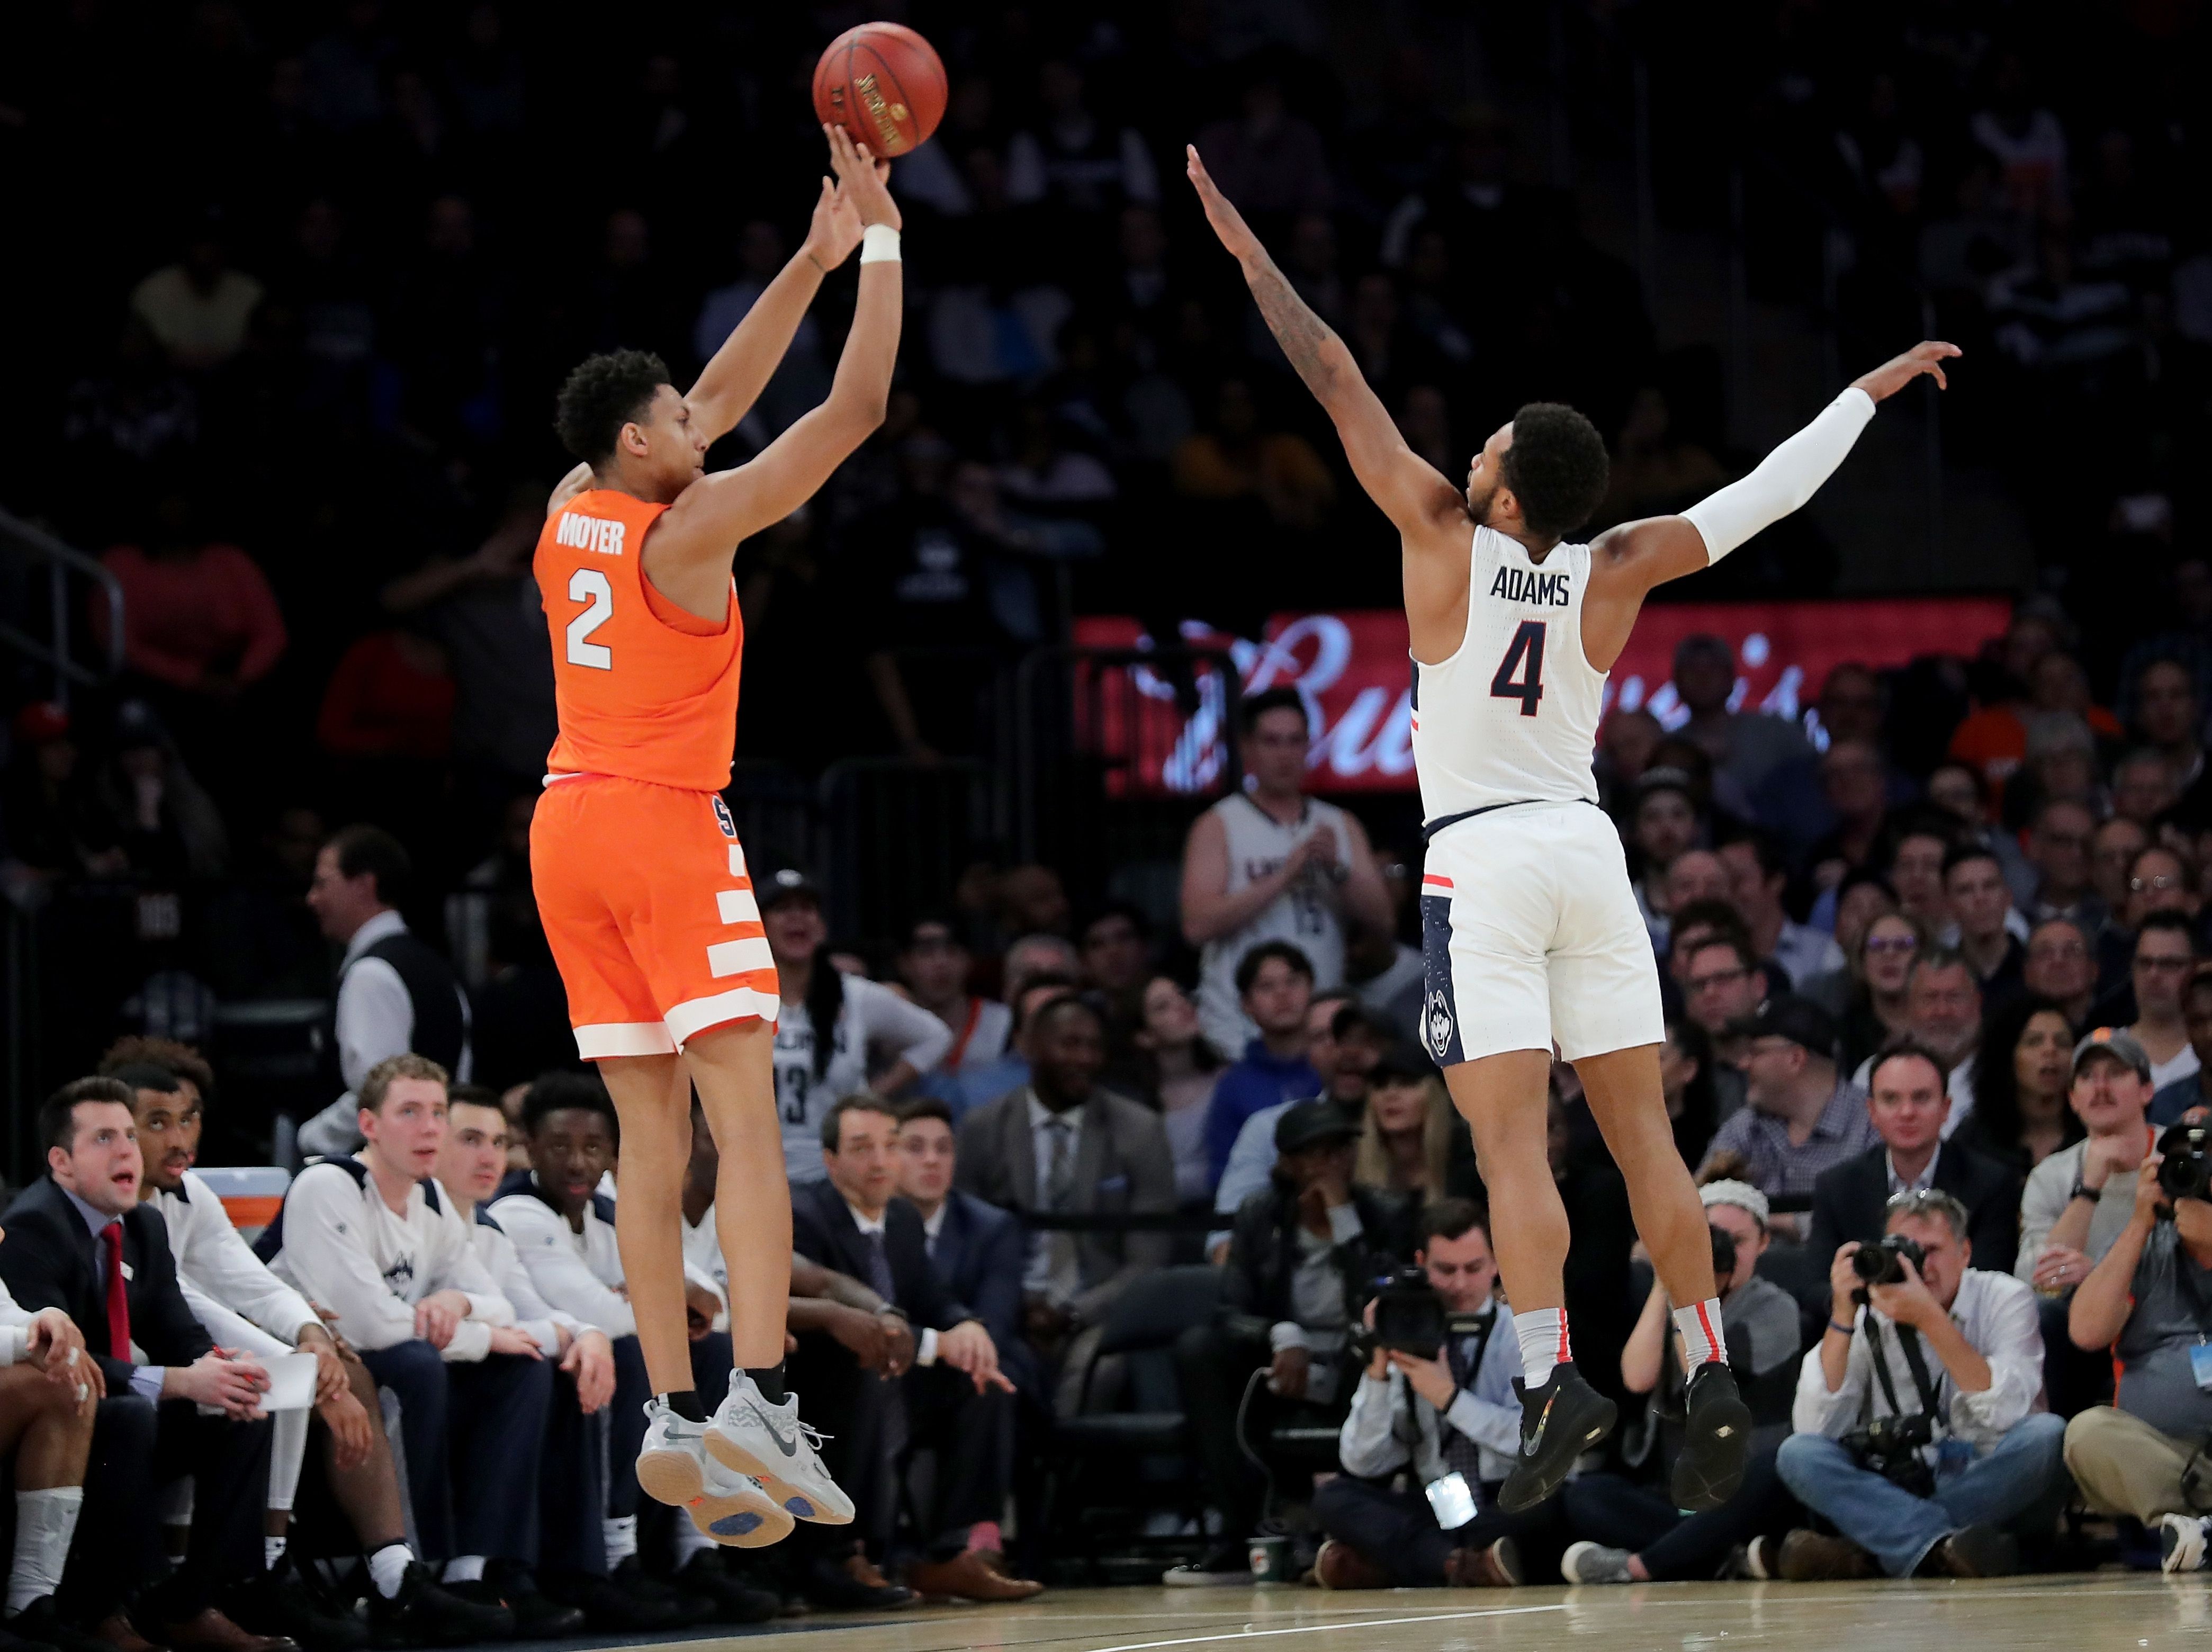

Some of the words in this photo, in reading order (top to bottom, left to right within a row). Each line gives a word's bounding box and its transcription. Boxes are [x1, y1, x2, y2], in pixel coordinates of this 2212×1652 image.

[555, 511, 626, 555] MOYER
[566, 567, 614, 671] 2
[1490, 566, 1570, 606] ADAMS
[1489, 619, 1547, 717] 4
